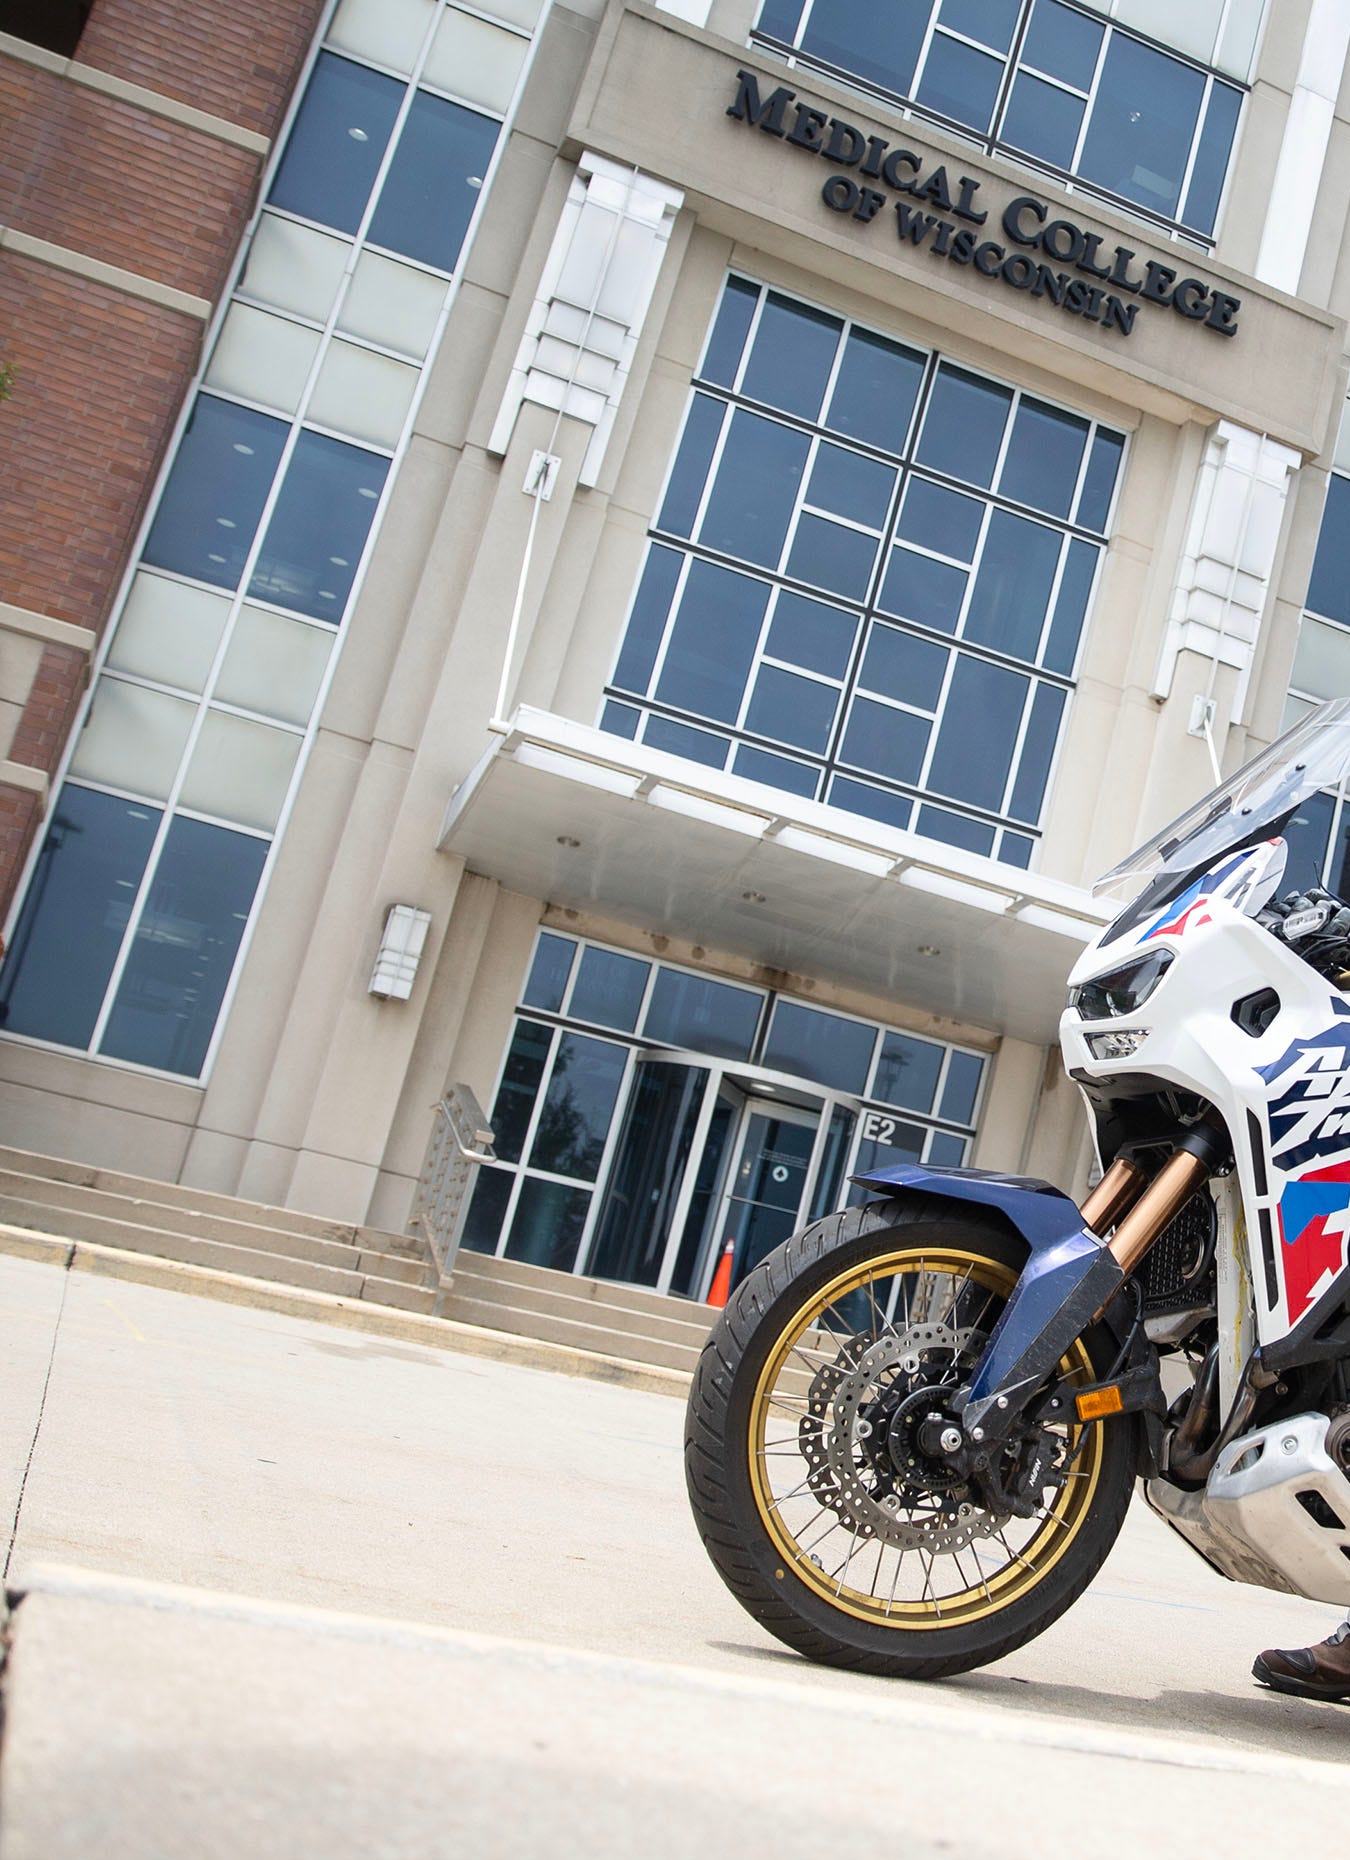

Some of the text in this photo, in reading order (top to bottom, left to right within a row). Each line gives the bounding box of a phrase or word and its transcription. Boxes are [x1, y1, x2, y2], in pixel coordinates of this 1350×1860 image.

[726, 70, 1241, 337] MEDICAL COLLEGE
[822, 176, 1139, 336] OF WISCONSIN
[863, 1114, 896, 1146] E2
